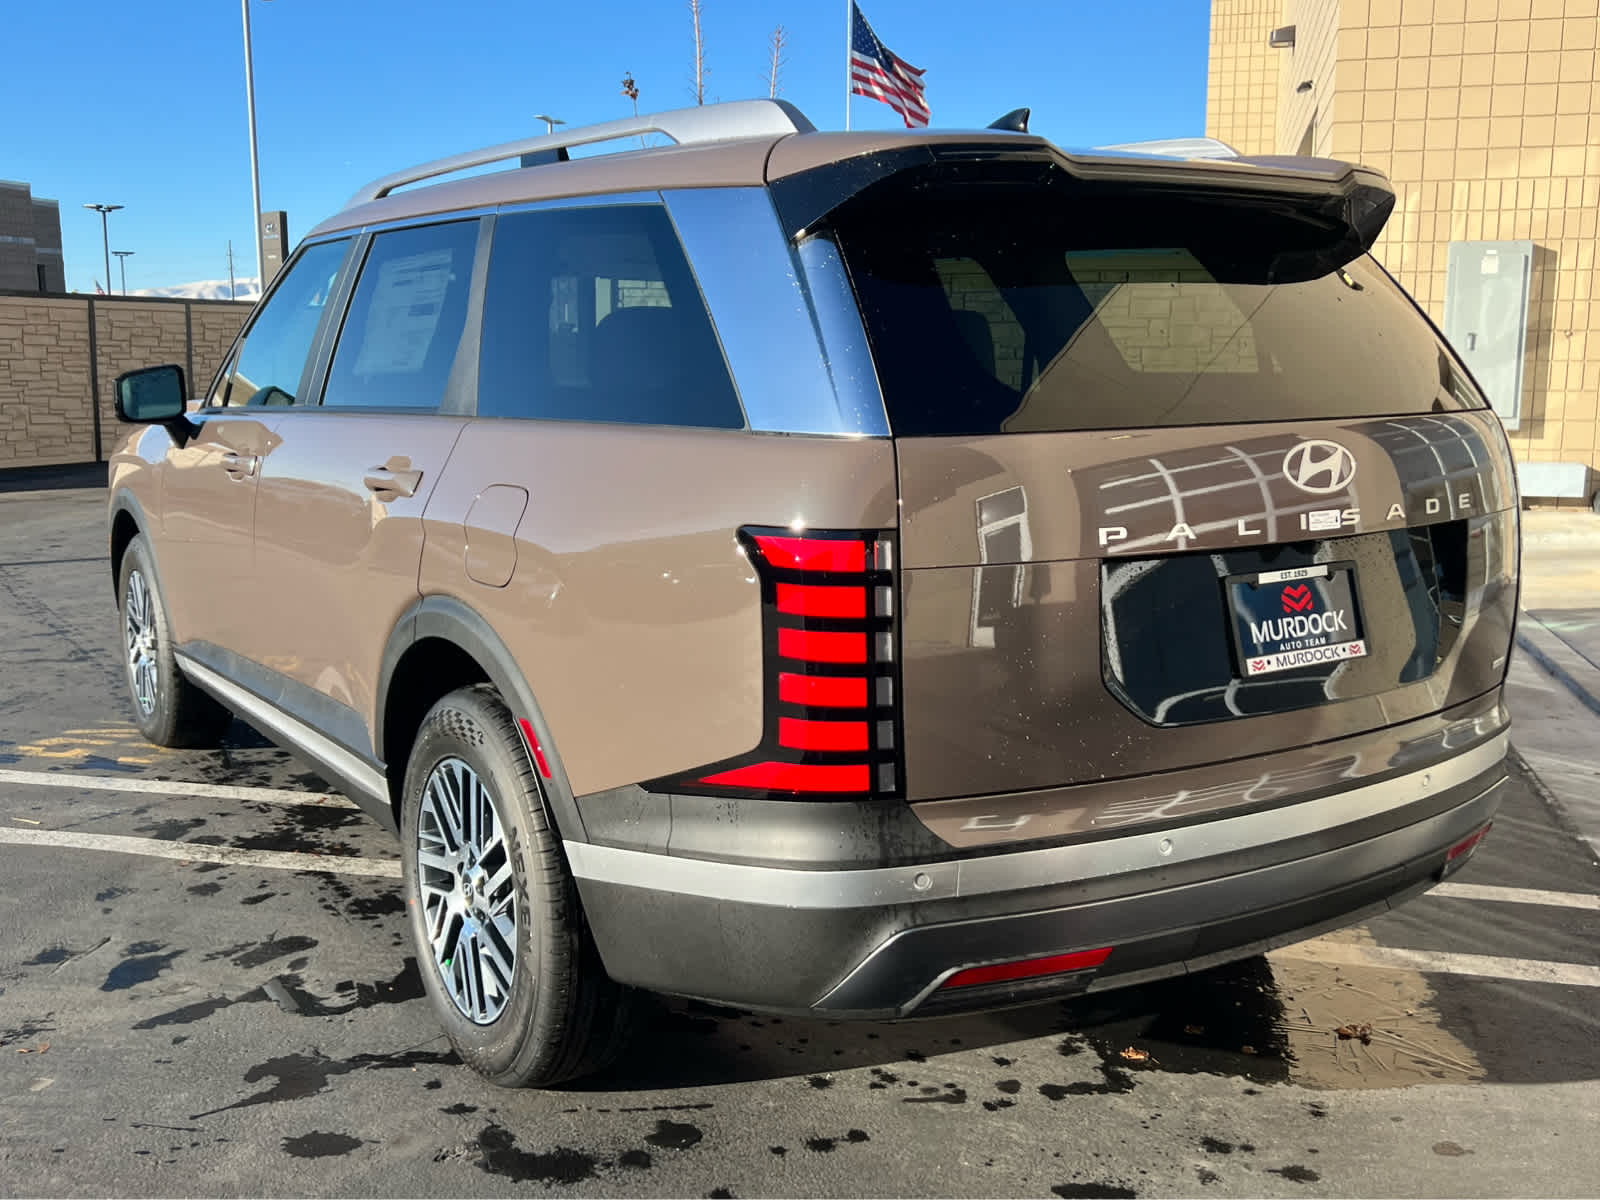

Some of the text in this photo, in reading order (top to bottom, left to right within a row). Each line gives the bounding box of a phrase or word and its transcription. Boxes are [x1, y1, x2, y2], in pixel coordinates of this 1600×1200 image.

[1099, 493, 1471, 546] PALISADE
[1250, 609, 1348, 644] MURDOCK
[1275, 646, 1341, 668] MURDOCK
[1280, 636, 1327, 651] AUTO TEAM
